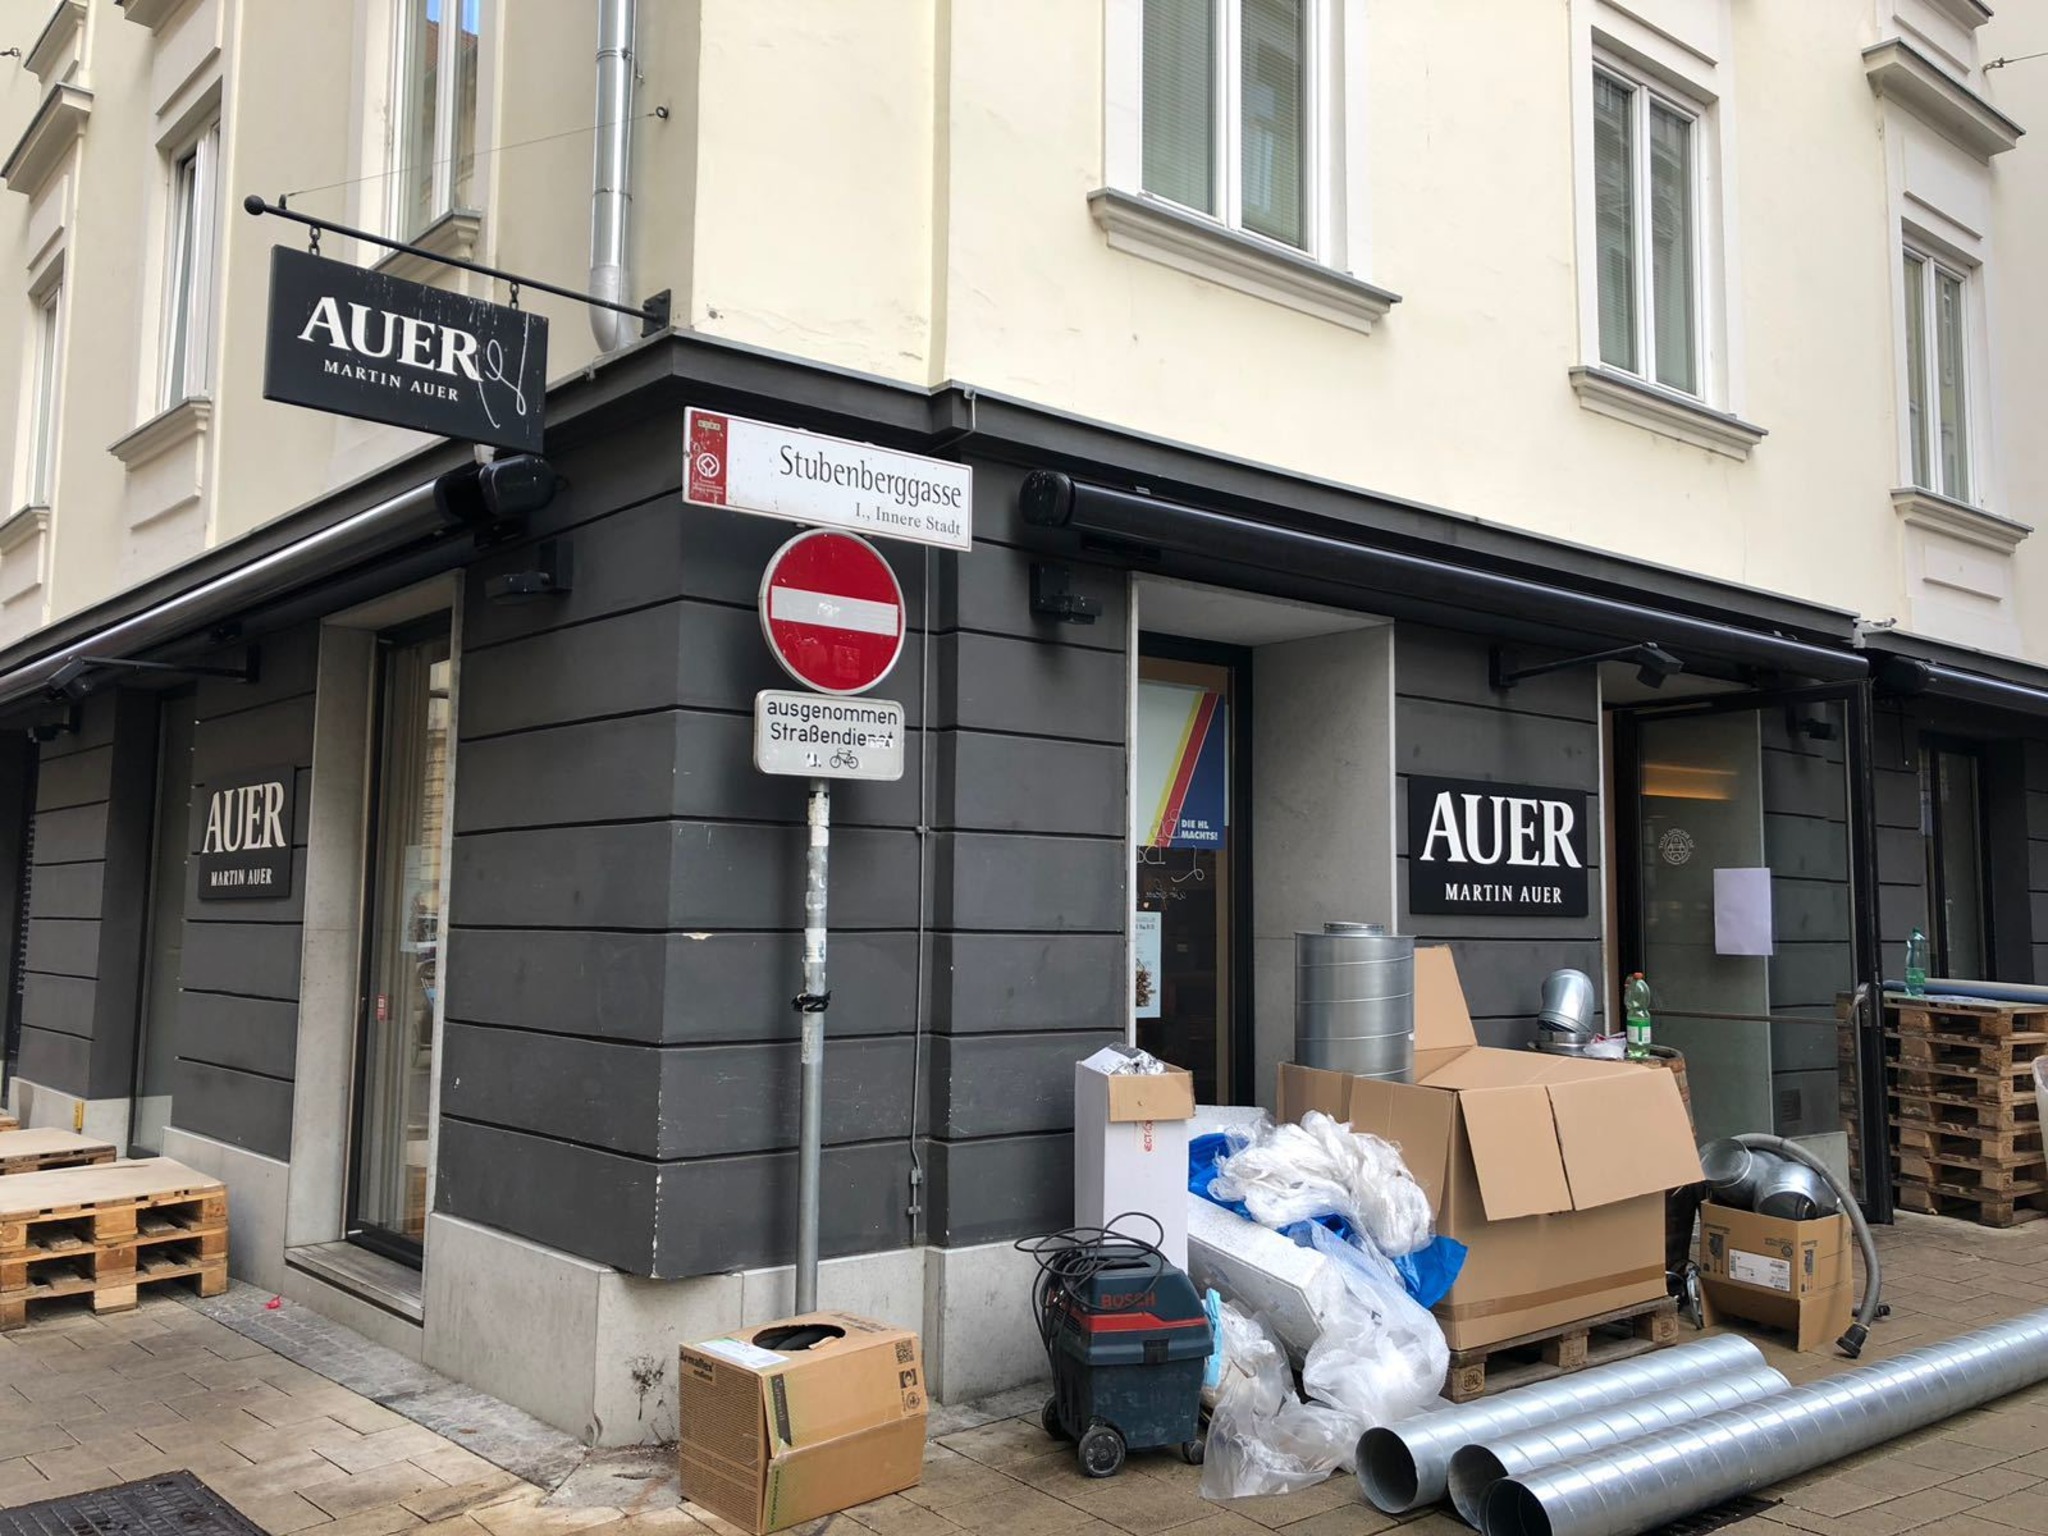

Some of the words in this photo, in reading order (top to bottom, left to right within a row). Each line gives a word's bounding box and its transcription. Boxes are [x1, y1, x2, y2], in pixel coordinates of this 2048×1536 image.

[297, 296, 484, 382] AUER
[324, 359, 401, 388] MARTIN
[410, 380, 459, 402] AUER
[779, 444, 962, 509] Stubenberggasse
[876, 506, 921, 528] Innere
[926, 516, 961, 536] Stadt
[767, 700, 897, 726] ausgenommen
[202, 781, 286, 853] AUER
[1181, 819, 1195, 829] DIE
[1419, 790, 1582, 868] AUER
[1181, 830, 1218, 841] MACHTS!
[211, 869, 244, 886] MARTIN
[247, 868, 272, 885] AUER
[1445, 883, 1513, 902] MARTIN
[1520, 886, 1562, 903] AUER
[1101, 1292, 1156, 1309] BOSCH
